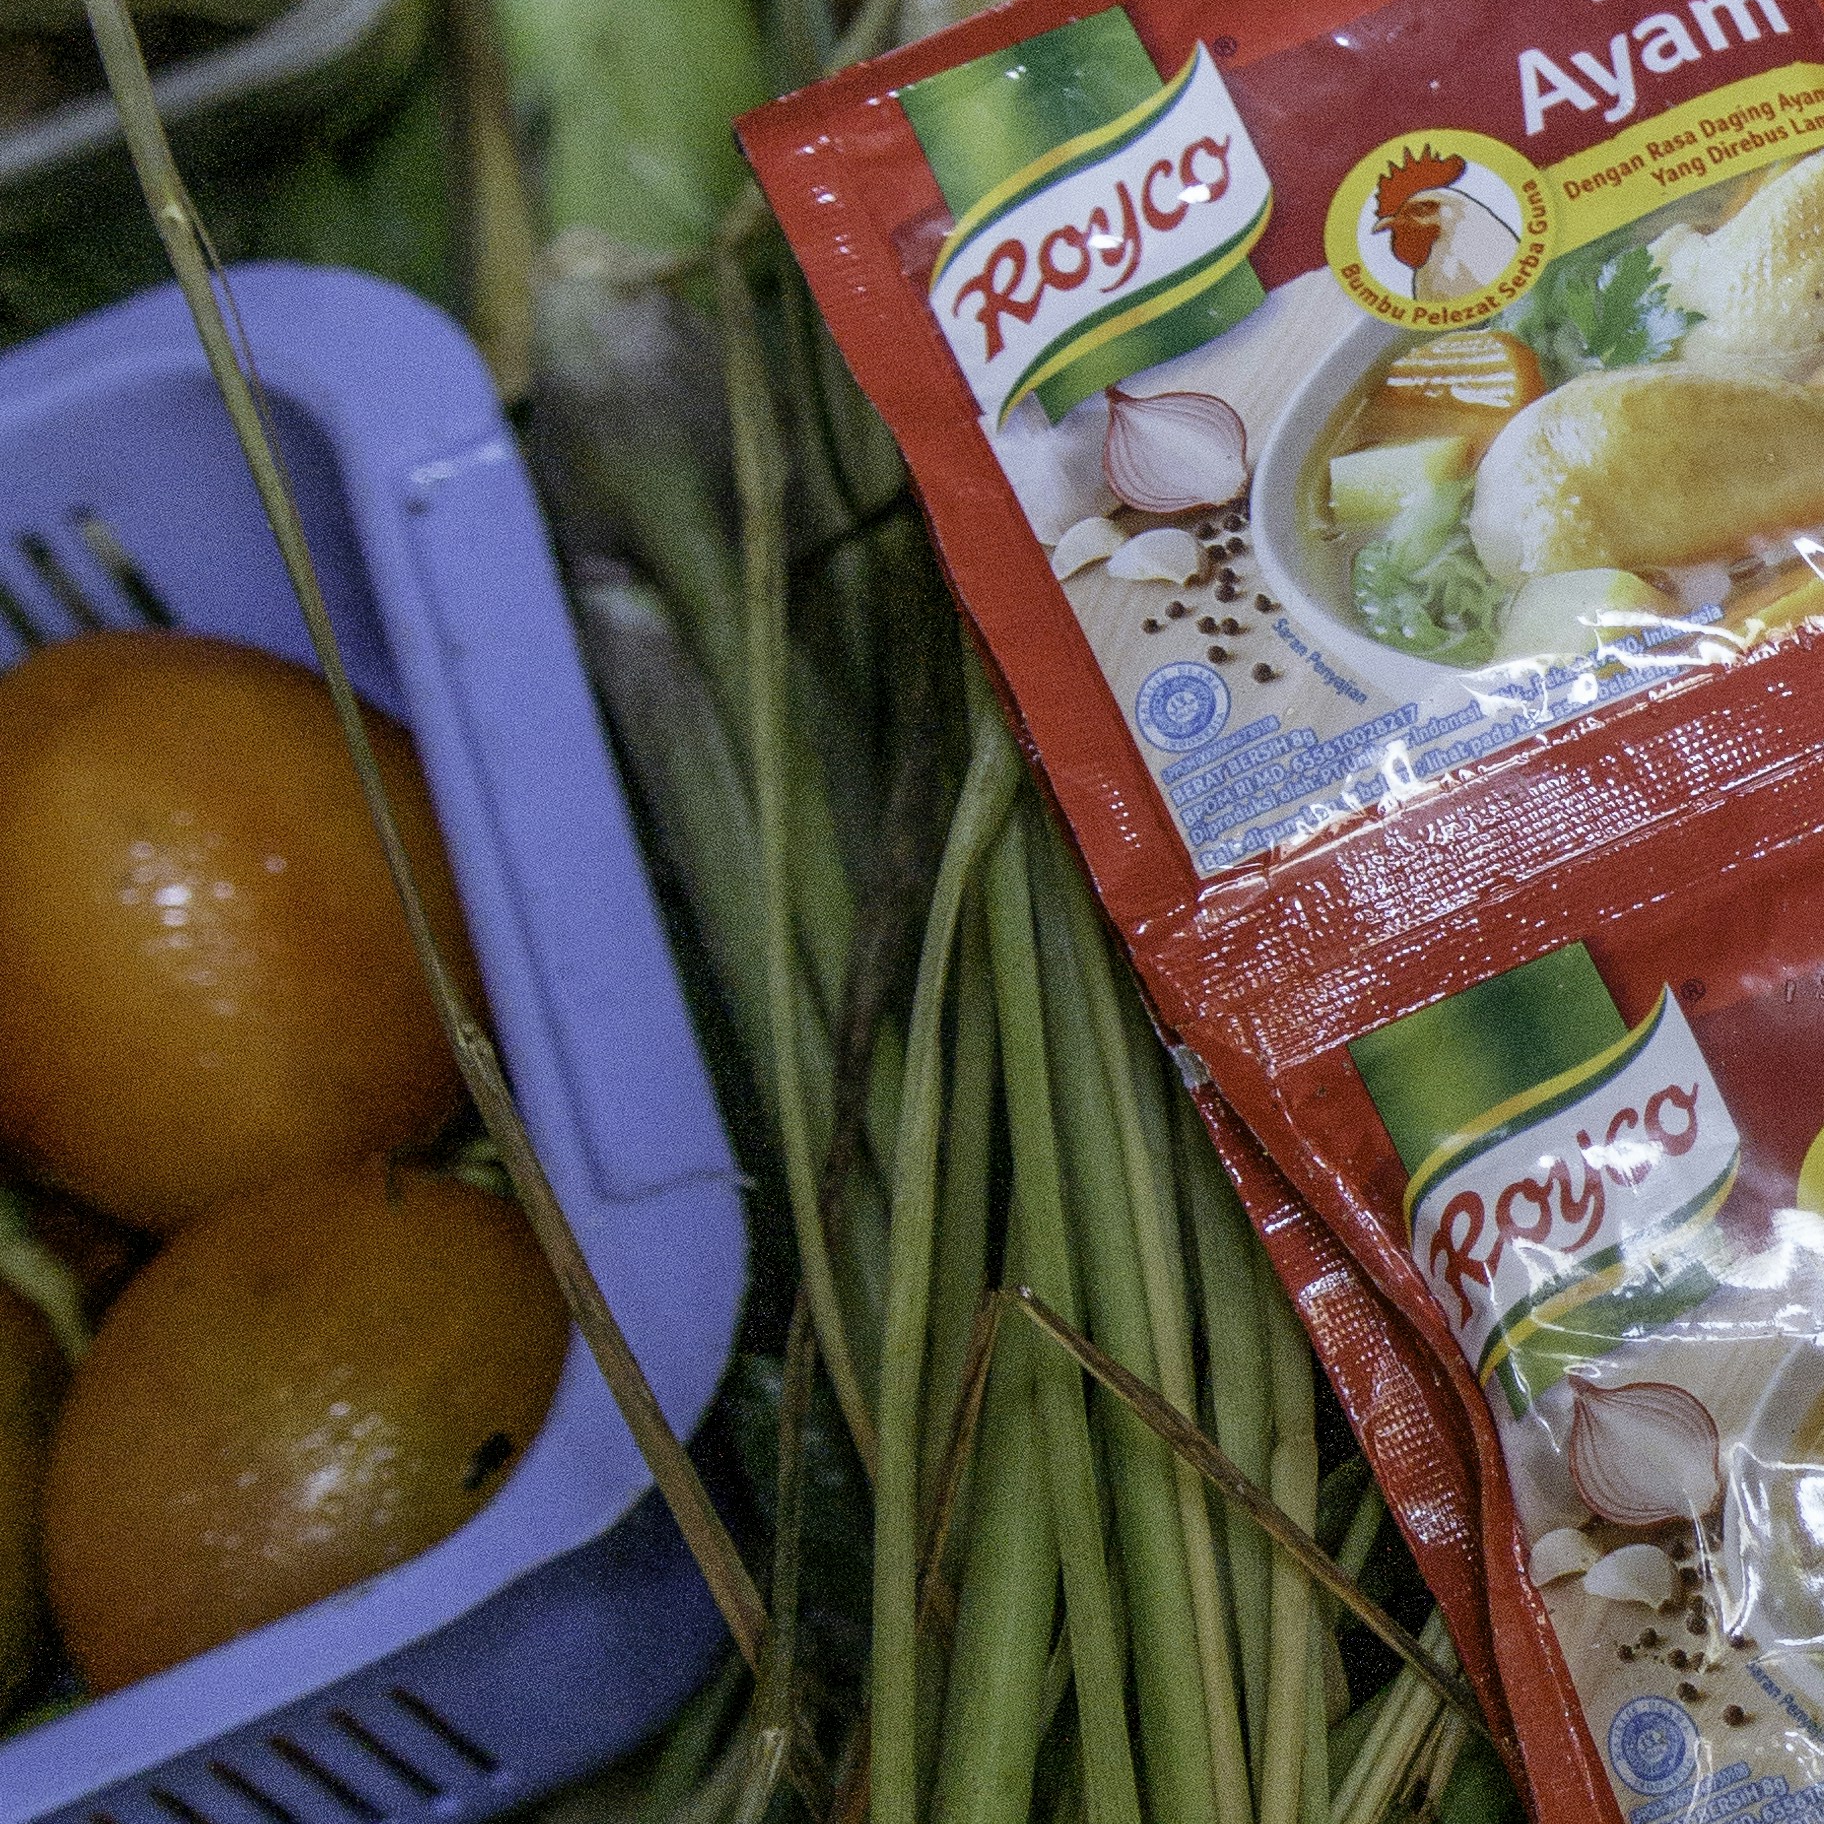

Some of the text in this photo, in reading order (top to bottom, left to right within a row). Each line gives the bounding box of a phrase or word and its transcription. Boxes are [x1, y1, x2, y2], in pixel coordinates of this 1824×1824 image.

[1562, 155, 1646, 201] Dengan
[1645, 131, 1699, 161] Rasa
[1697, 102, 1777, 138] Daging
[1650, 157, 1708, 189] Yang
[1707, 121, 1790, 164] Direbus
[953, 133, 1231, 364] Royco
[1340, 179, 1548, 325] Bumbu Pelezat Serba Guna
[1271, 617, 1369, 705] Saran Penyajian
[1171, 769, 1227, 806] BERAT
[1225, 739, 1290, 776] BERSIH
[1289, 727, 1317, 751] 8g
[1180, 790, 1234, 826] BPOM
[1234, 779, 1253, 800] RI
[1290, 702, 1418, 774] 655610028217
[1188, 793, 1278, 848] Diproduksi
[1278, 776, 1320, 804] oleh:
[1319, 760, 1347, 786] PT
[1343, 729, 1412, 775] Unilr
[1411, 700, 1488, 745] Indonesi
[1642, 604, 1724, 648] Indoesia
[1423, 742, 1470, 775] lihat
[1466, 723, 1516, 765] pada
[1429, 1081, 1700, 1330] Royco
[1695, 1782, 1761, 1824] BERSIH
[1760, 1776, 1789, 1801] 8g
